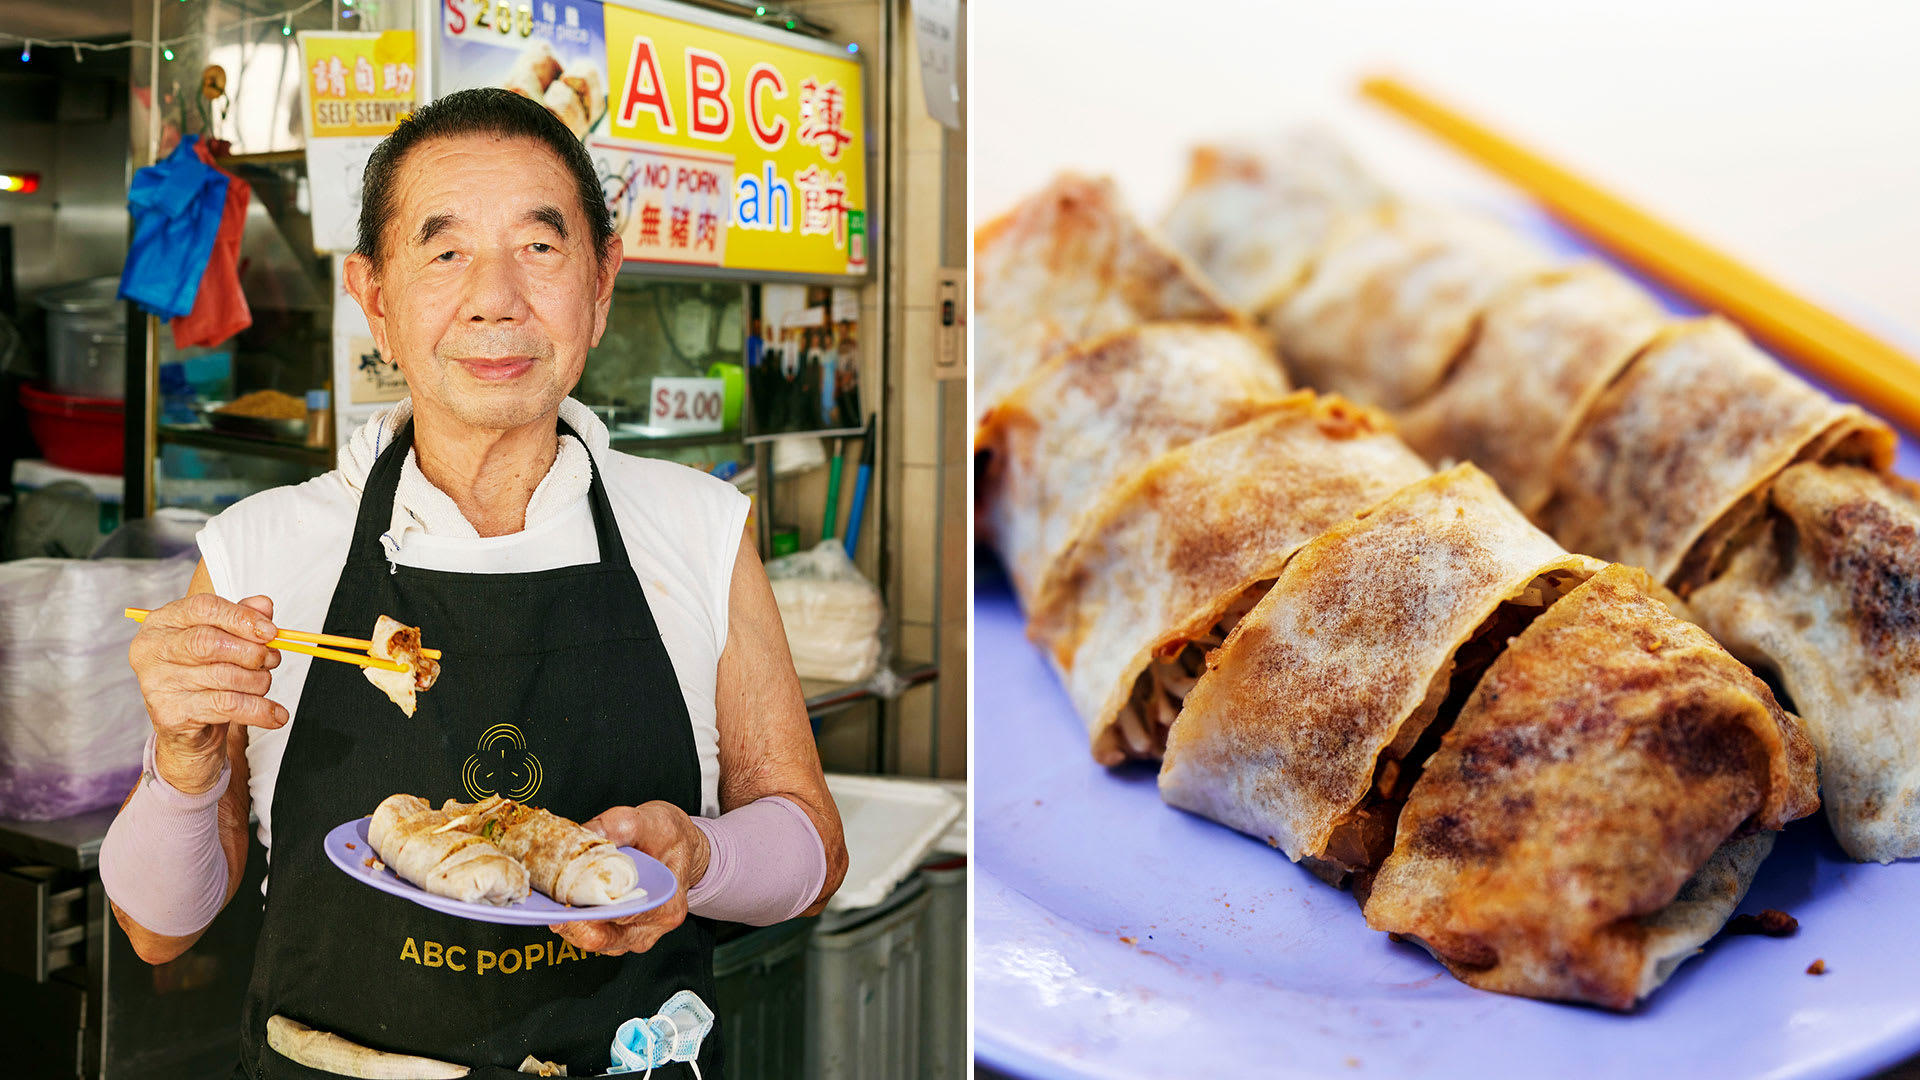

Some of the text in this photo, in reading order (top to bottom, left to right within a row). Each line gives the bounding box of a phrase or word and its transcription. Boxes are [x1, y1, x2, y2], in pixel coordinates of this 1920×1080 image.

[312, 56, 414, 97] 請自助
[618, 38, 788, 149] ABC
[318, 101, 350, 124] SELF
[645, 164, 721, 195] NO PORK
[400, 937, 467, 972] ABC
